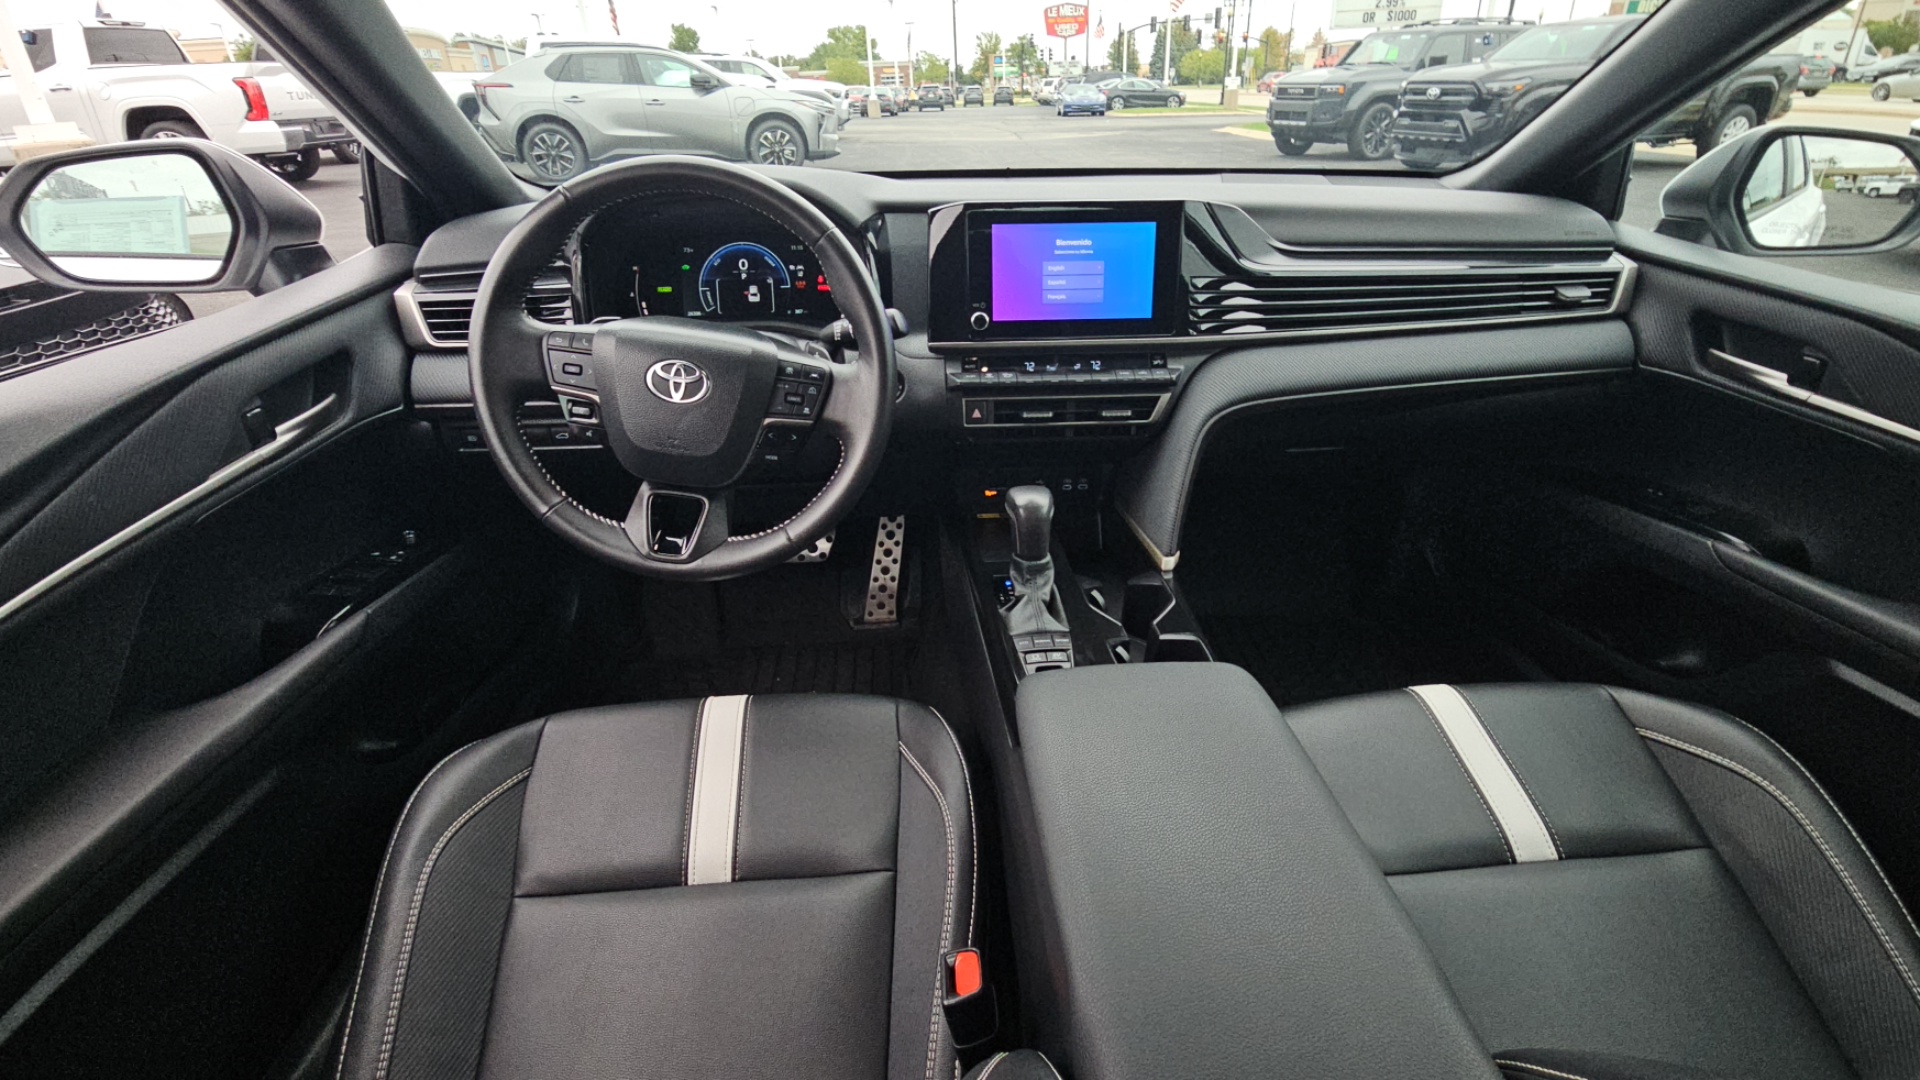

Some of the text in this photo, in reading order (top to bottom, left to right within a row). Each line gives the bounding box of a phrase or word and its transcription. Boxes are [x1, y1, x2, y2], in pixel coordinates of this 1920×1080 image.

[1047, 8, 1058, 18] LE
[1362, 12, 1376, 23] OR
[738, 258, 749, 270] 0
[1024, 362, 1036, 372] 72
[1090, 360, 1102, 371] 72
